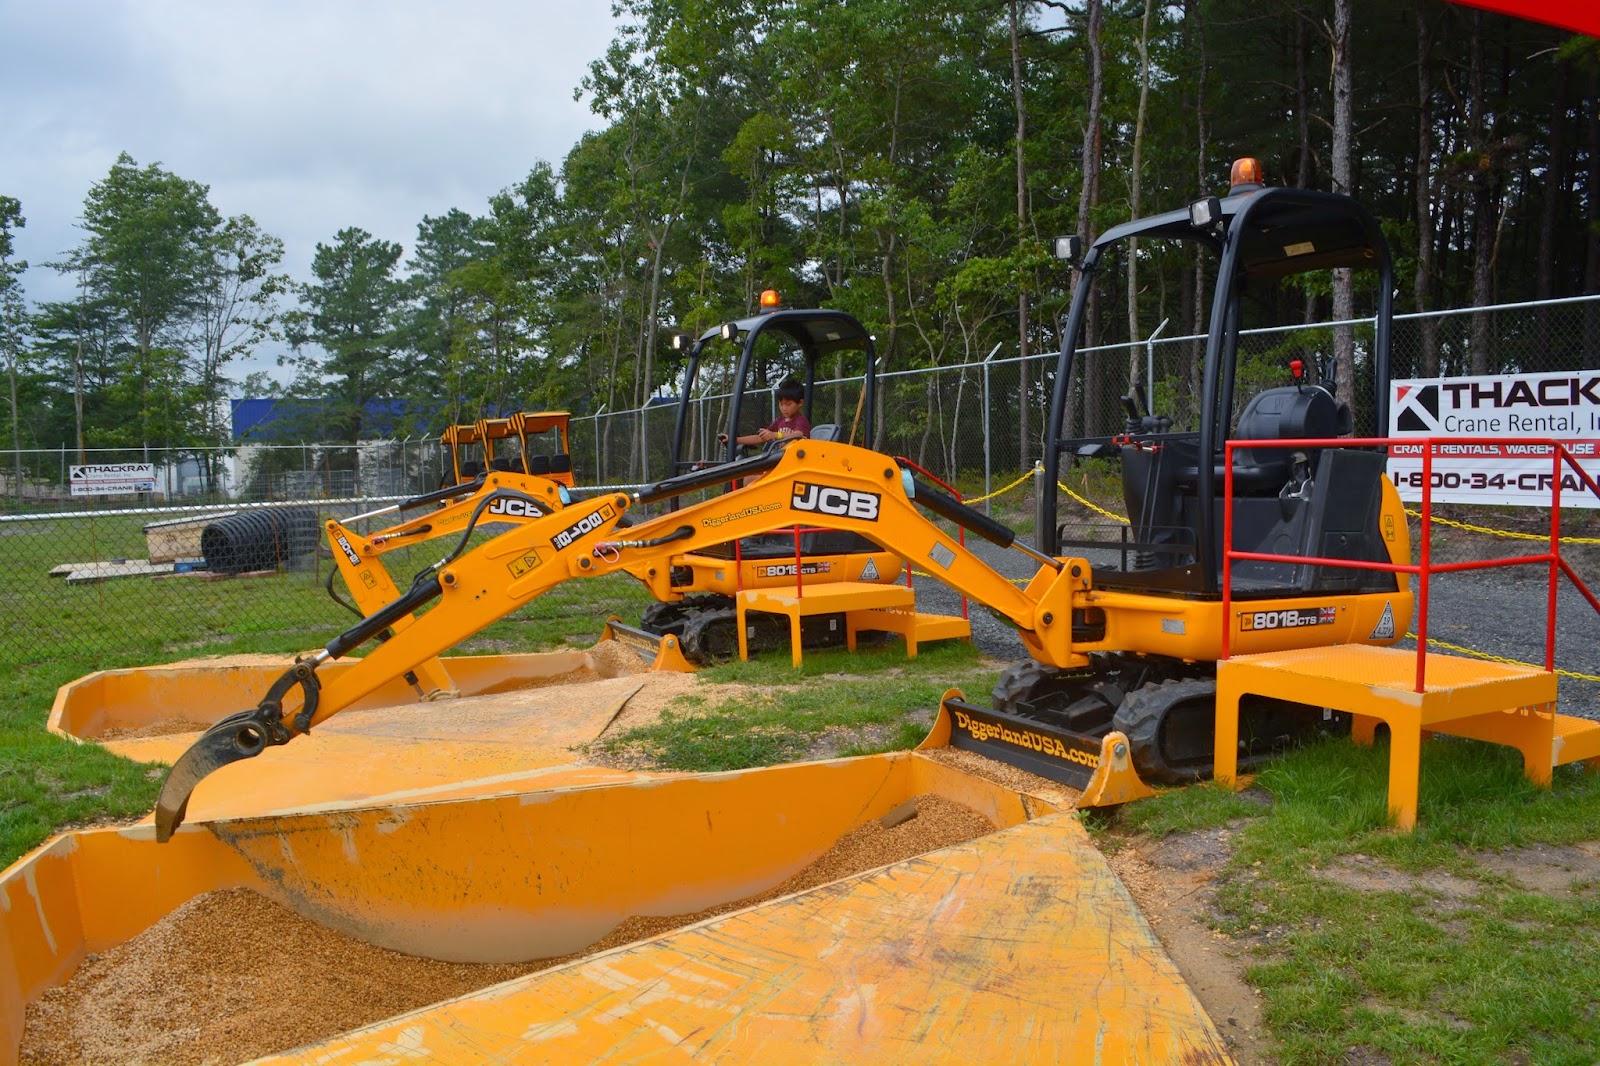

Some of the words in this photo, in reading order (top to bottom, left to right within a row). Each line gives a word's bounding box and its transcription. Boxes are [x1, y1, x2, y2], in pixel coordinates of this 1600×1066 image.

[1442, 377, 1600, 409] THACK
[1444, 414, 1501, 433] Crane
[1508, 411, 1582, 435] Rental,
[1440, 444, 1502, 456] RENTALS,
[1505, 443, 1595, 455] WAREHUSE
[87, 465, 151, 473] THACKRAY
[489, 498, 544, 518] JCB
[792, 485, 879, 519] JCB
[702, 502, 782, 527] DiggerlandUSA.com
[954, 711, 1100, 768] DiggerlandUSA.com
